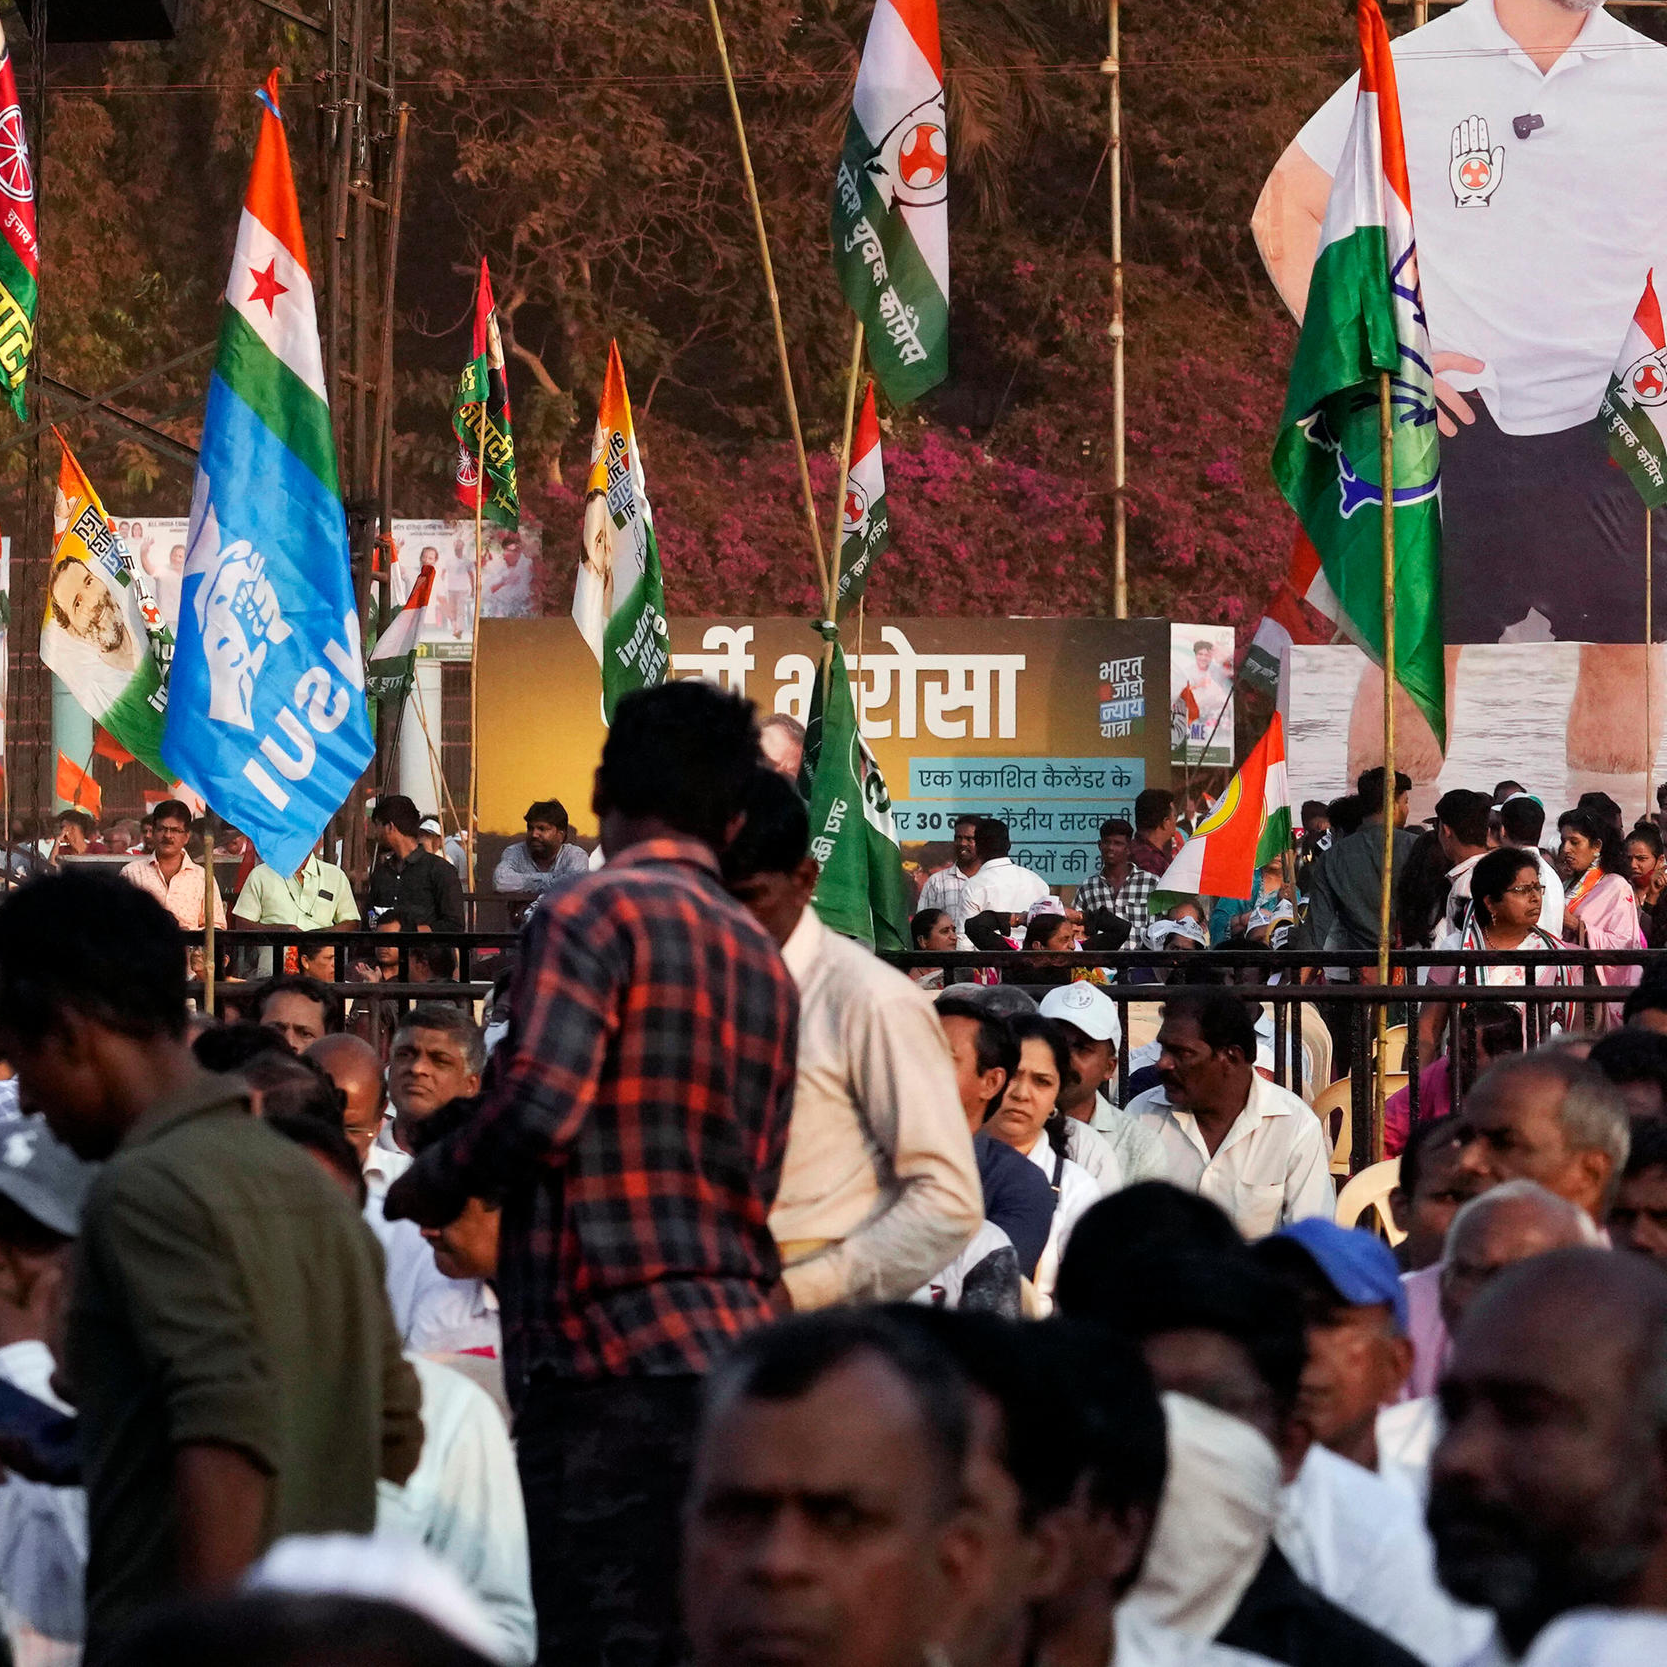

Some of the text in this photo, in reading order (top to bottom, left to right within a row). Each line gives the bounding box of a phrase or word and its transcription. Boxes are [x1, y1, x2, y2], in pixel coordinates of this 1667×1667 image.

[844, 216, 888, 287] युवक
[1608, 412, 1640, 448] युवक
[1099, 656, 1145, 683] भारत
[1111, 678, 1145, 699] जोड़ो
[1100, 698, 1145, 721] न्याय
[1100, 720, 1131, 739] यात्रा
[919, 764, 1133, 789] एक प्रकाशित कैलेंडर के
[917, 813, 942, 831] 30
[997, 807, 1053, 832] केंद्रीय
[1062, 850, 1088, 874] की
